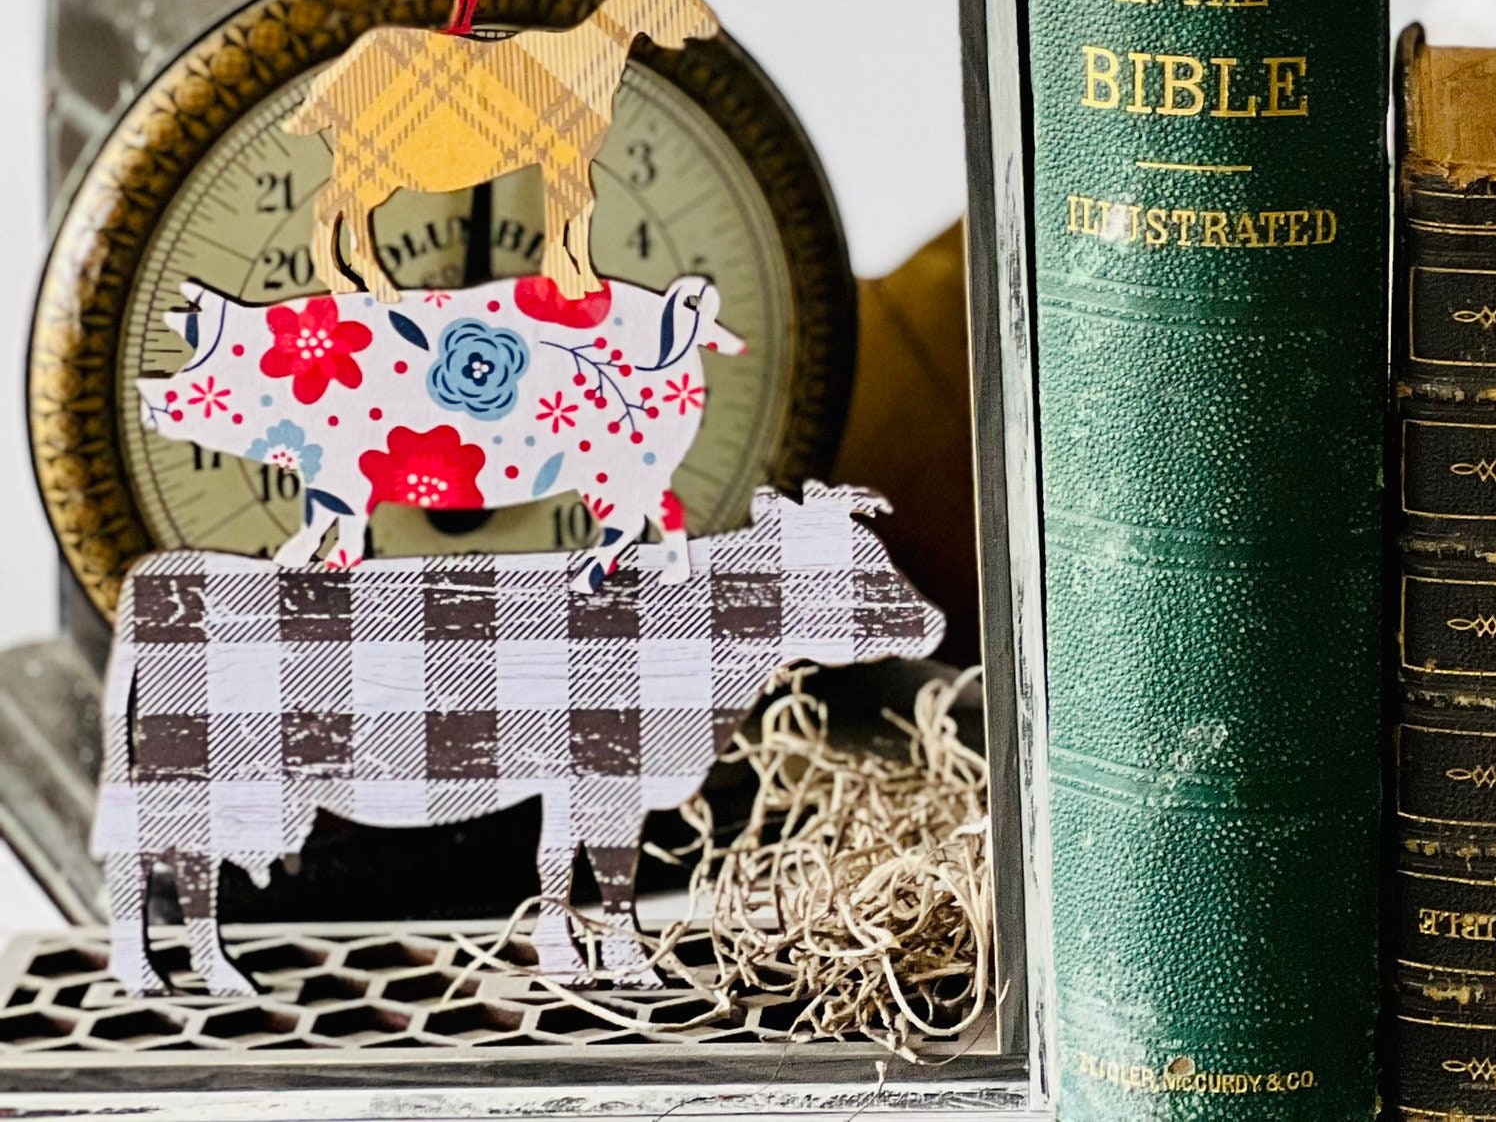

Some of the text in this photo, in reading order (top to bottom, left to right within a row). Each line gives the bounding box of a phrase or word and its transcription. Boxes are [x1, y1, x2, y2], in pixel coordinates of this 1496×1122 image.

[1081, 45, 1309, 117] BIBLE
[626, 140, 656, 186] 3
[256, 171, 295, 212] 21
[626, 219, 653, 260] 4
[263, 245, 315, 290] 20
[259, 463, 300, 502] 16
[554, 501, 593, 548] 10
[1265, 1073, 1286, 1093] &
[1287, 1070, 1319, 1091] CO.
